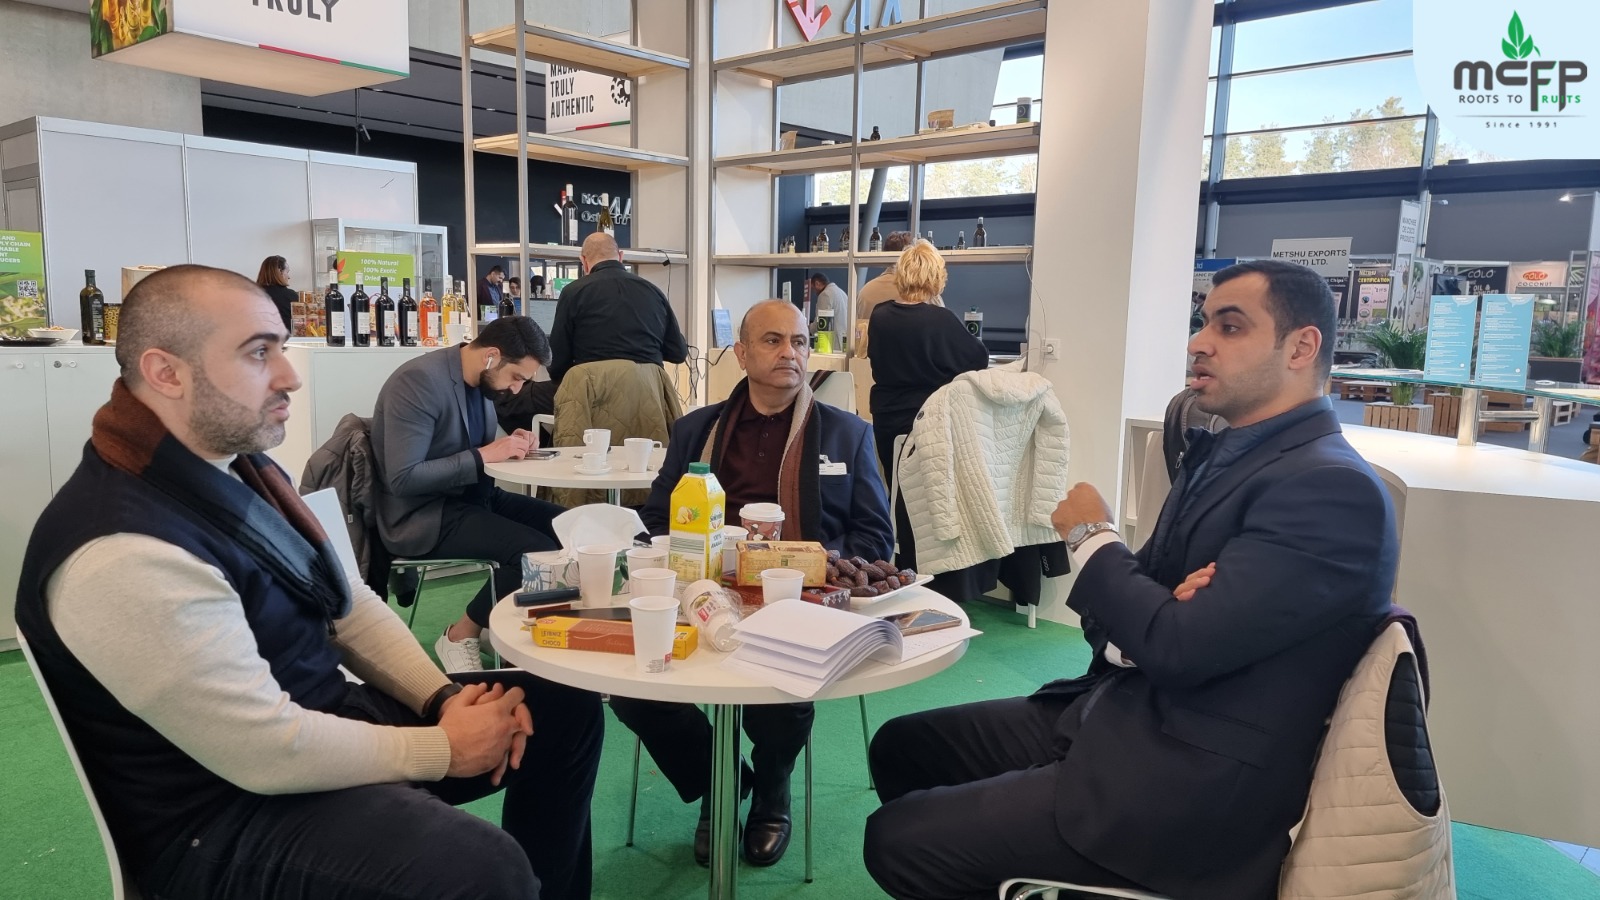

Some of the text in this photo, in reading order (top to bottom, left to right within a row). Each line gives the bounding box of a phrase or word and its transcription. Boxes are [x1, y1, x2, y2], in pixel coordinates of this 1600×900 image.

[550, 77, 575, 98] TRULY
[550, 94, 594, 119] AUTHENTIC
[1308, 249, 1347, 257] EXPORTS
[1311, 258, 1329, 266] LTD.
[542, 639, 561, 647] CHOCO
